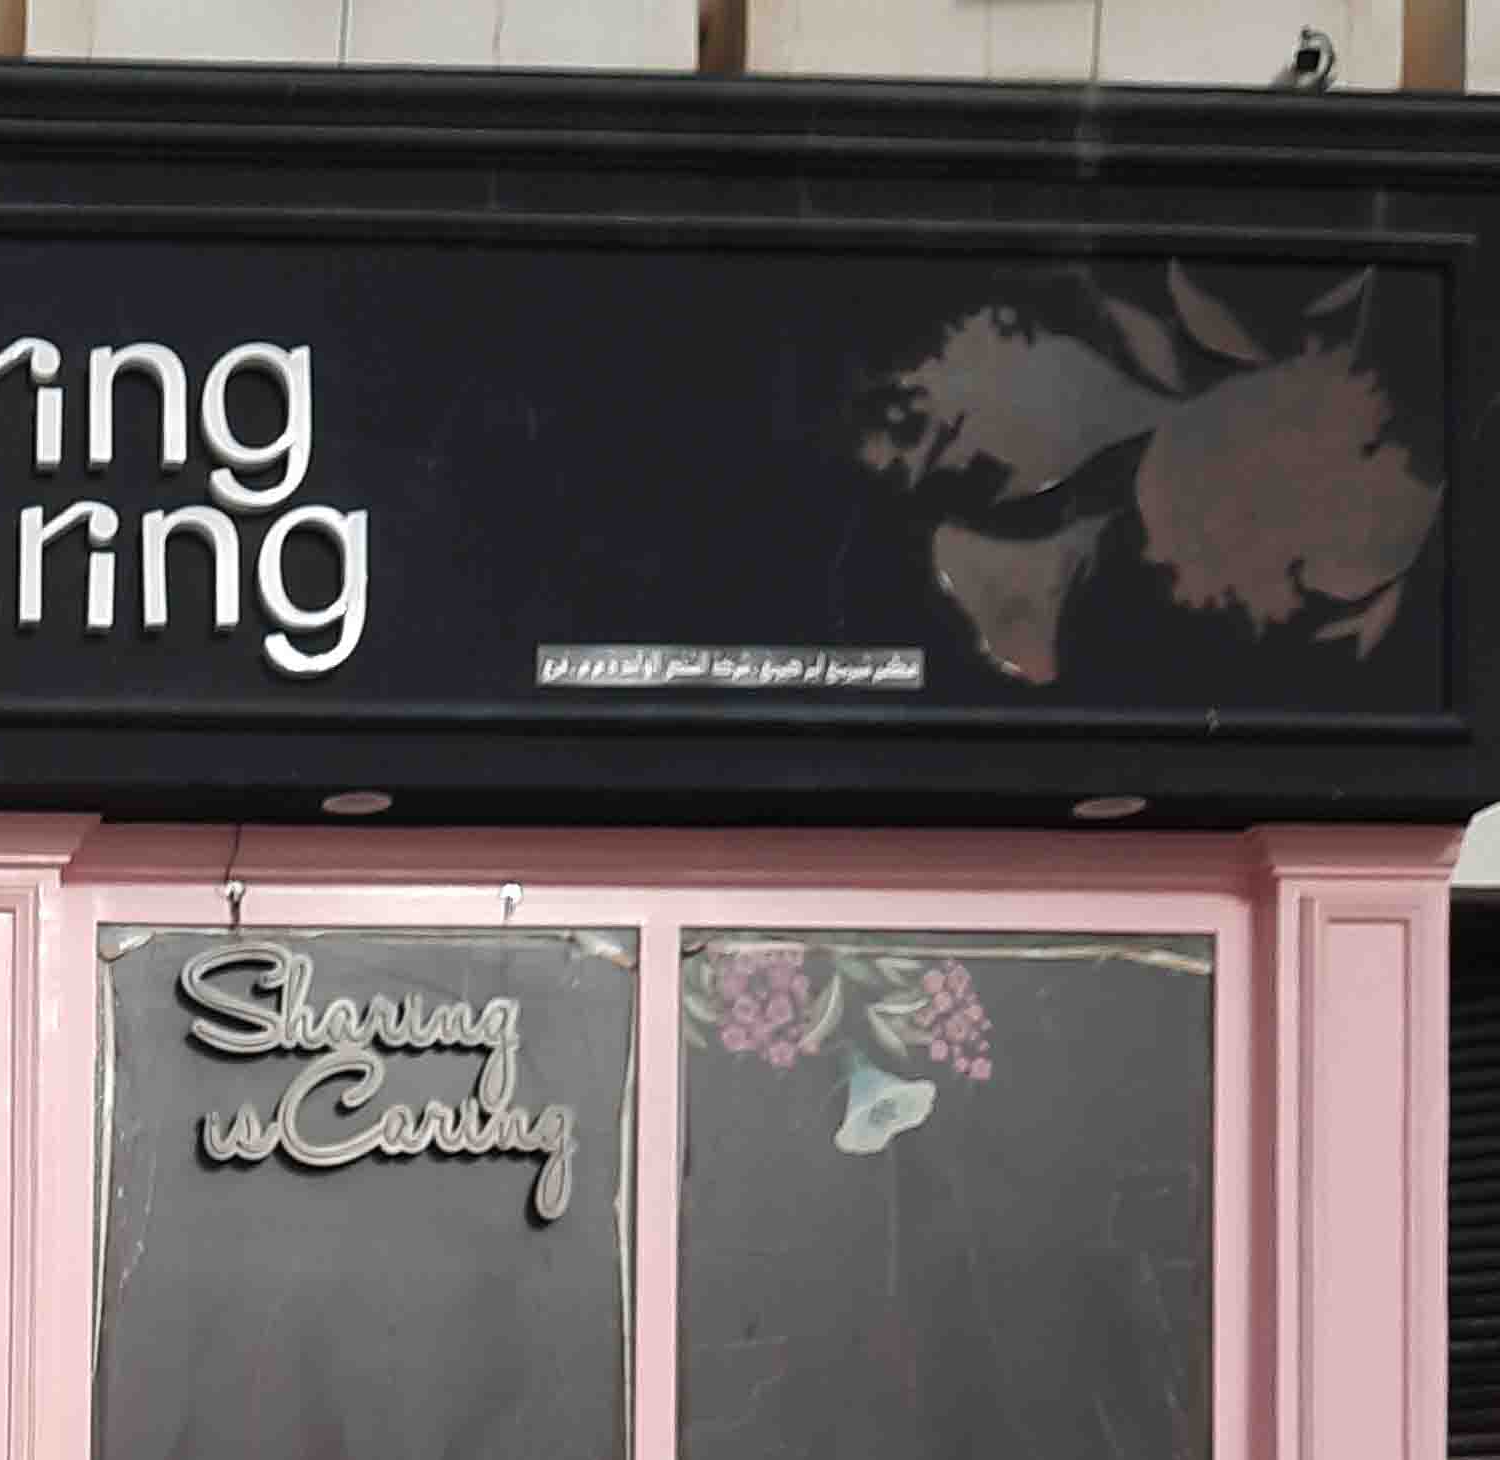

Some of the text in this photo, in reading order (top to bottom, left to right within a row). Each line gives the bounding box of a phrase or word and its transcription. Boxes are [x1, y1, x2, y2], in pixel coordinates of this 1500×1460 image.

[180, 941, 522, 1109] Sharing
[201, 1047, 579, 1222] is Caring
